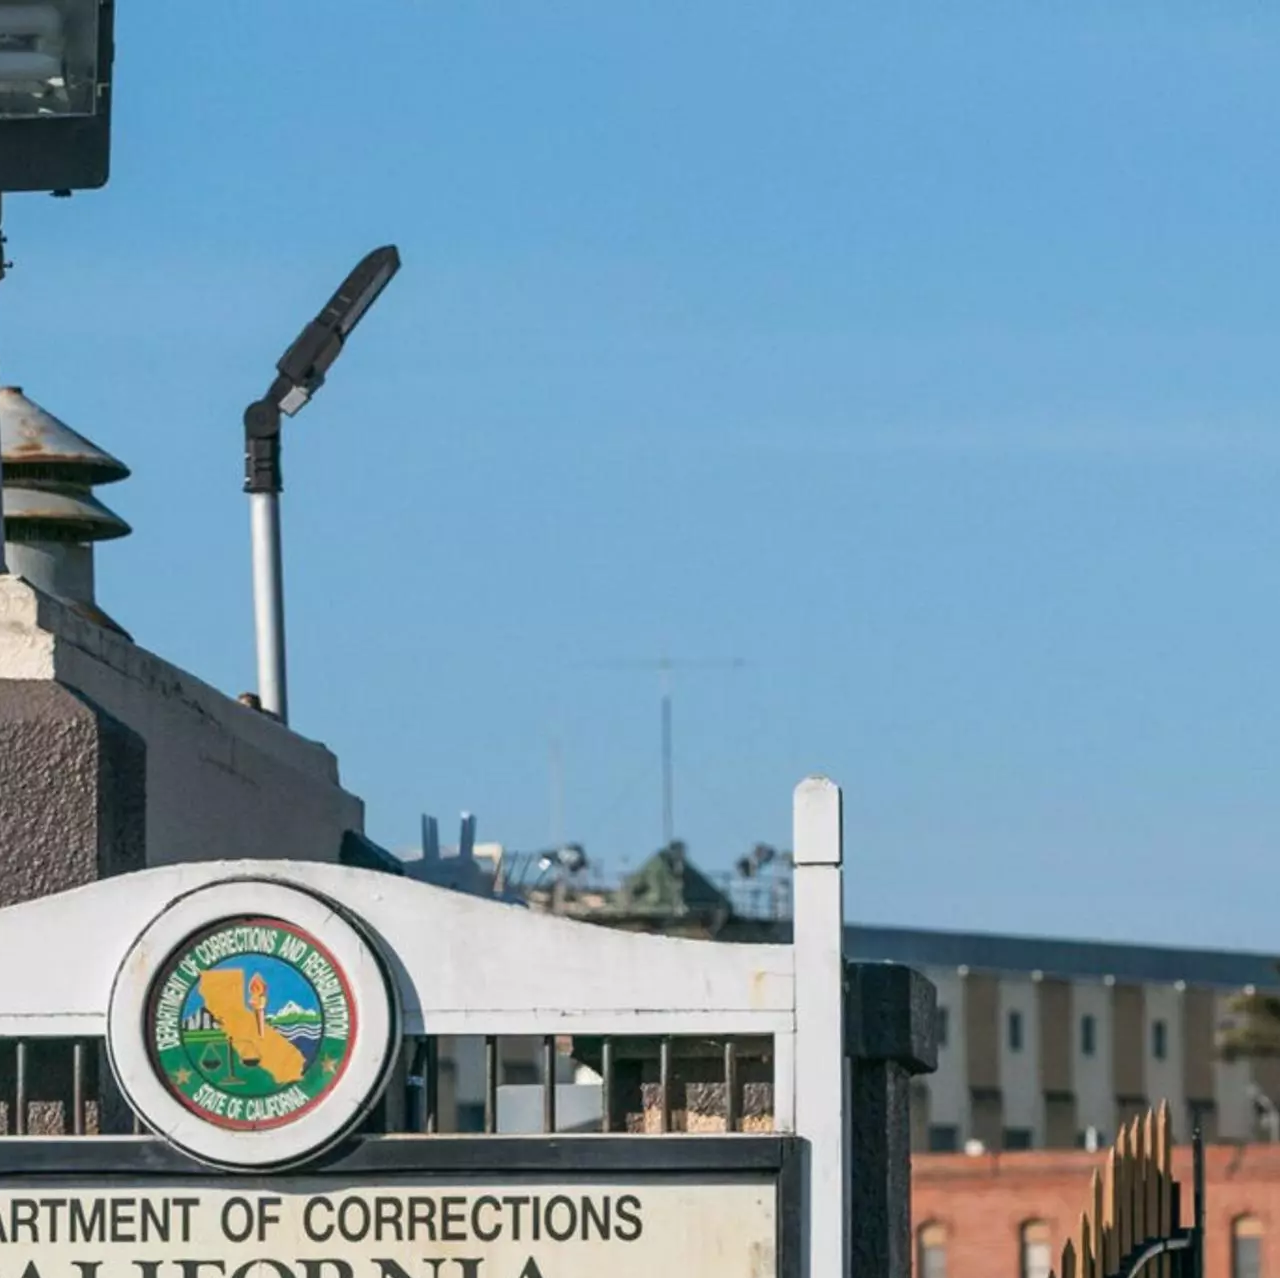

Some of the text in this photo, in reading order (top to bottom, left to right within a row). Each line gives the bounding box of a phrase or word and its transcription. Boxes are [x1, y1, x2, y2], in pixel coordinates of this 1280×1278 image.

[156, 972, 191, 1050] DEPARTMENT
[179, 954, 202, 977] OF
[195, 926, 278, 964] CORRECTIONS
[278, 933, 308, 963] AND
[192, 1083, 228, 1115] STATE
[228, 1098, 243, 1119] OF
[220, 1196, 284, 1244] OF
[303, 1194, 643, 1243] CORRECTIONS
